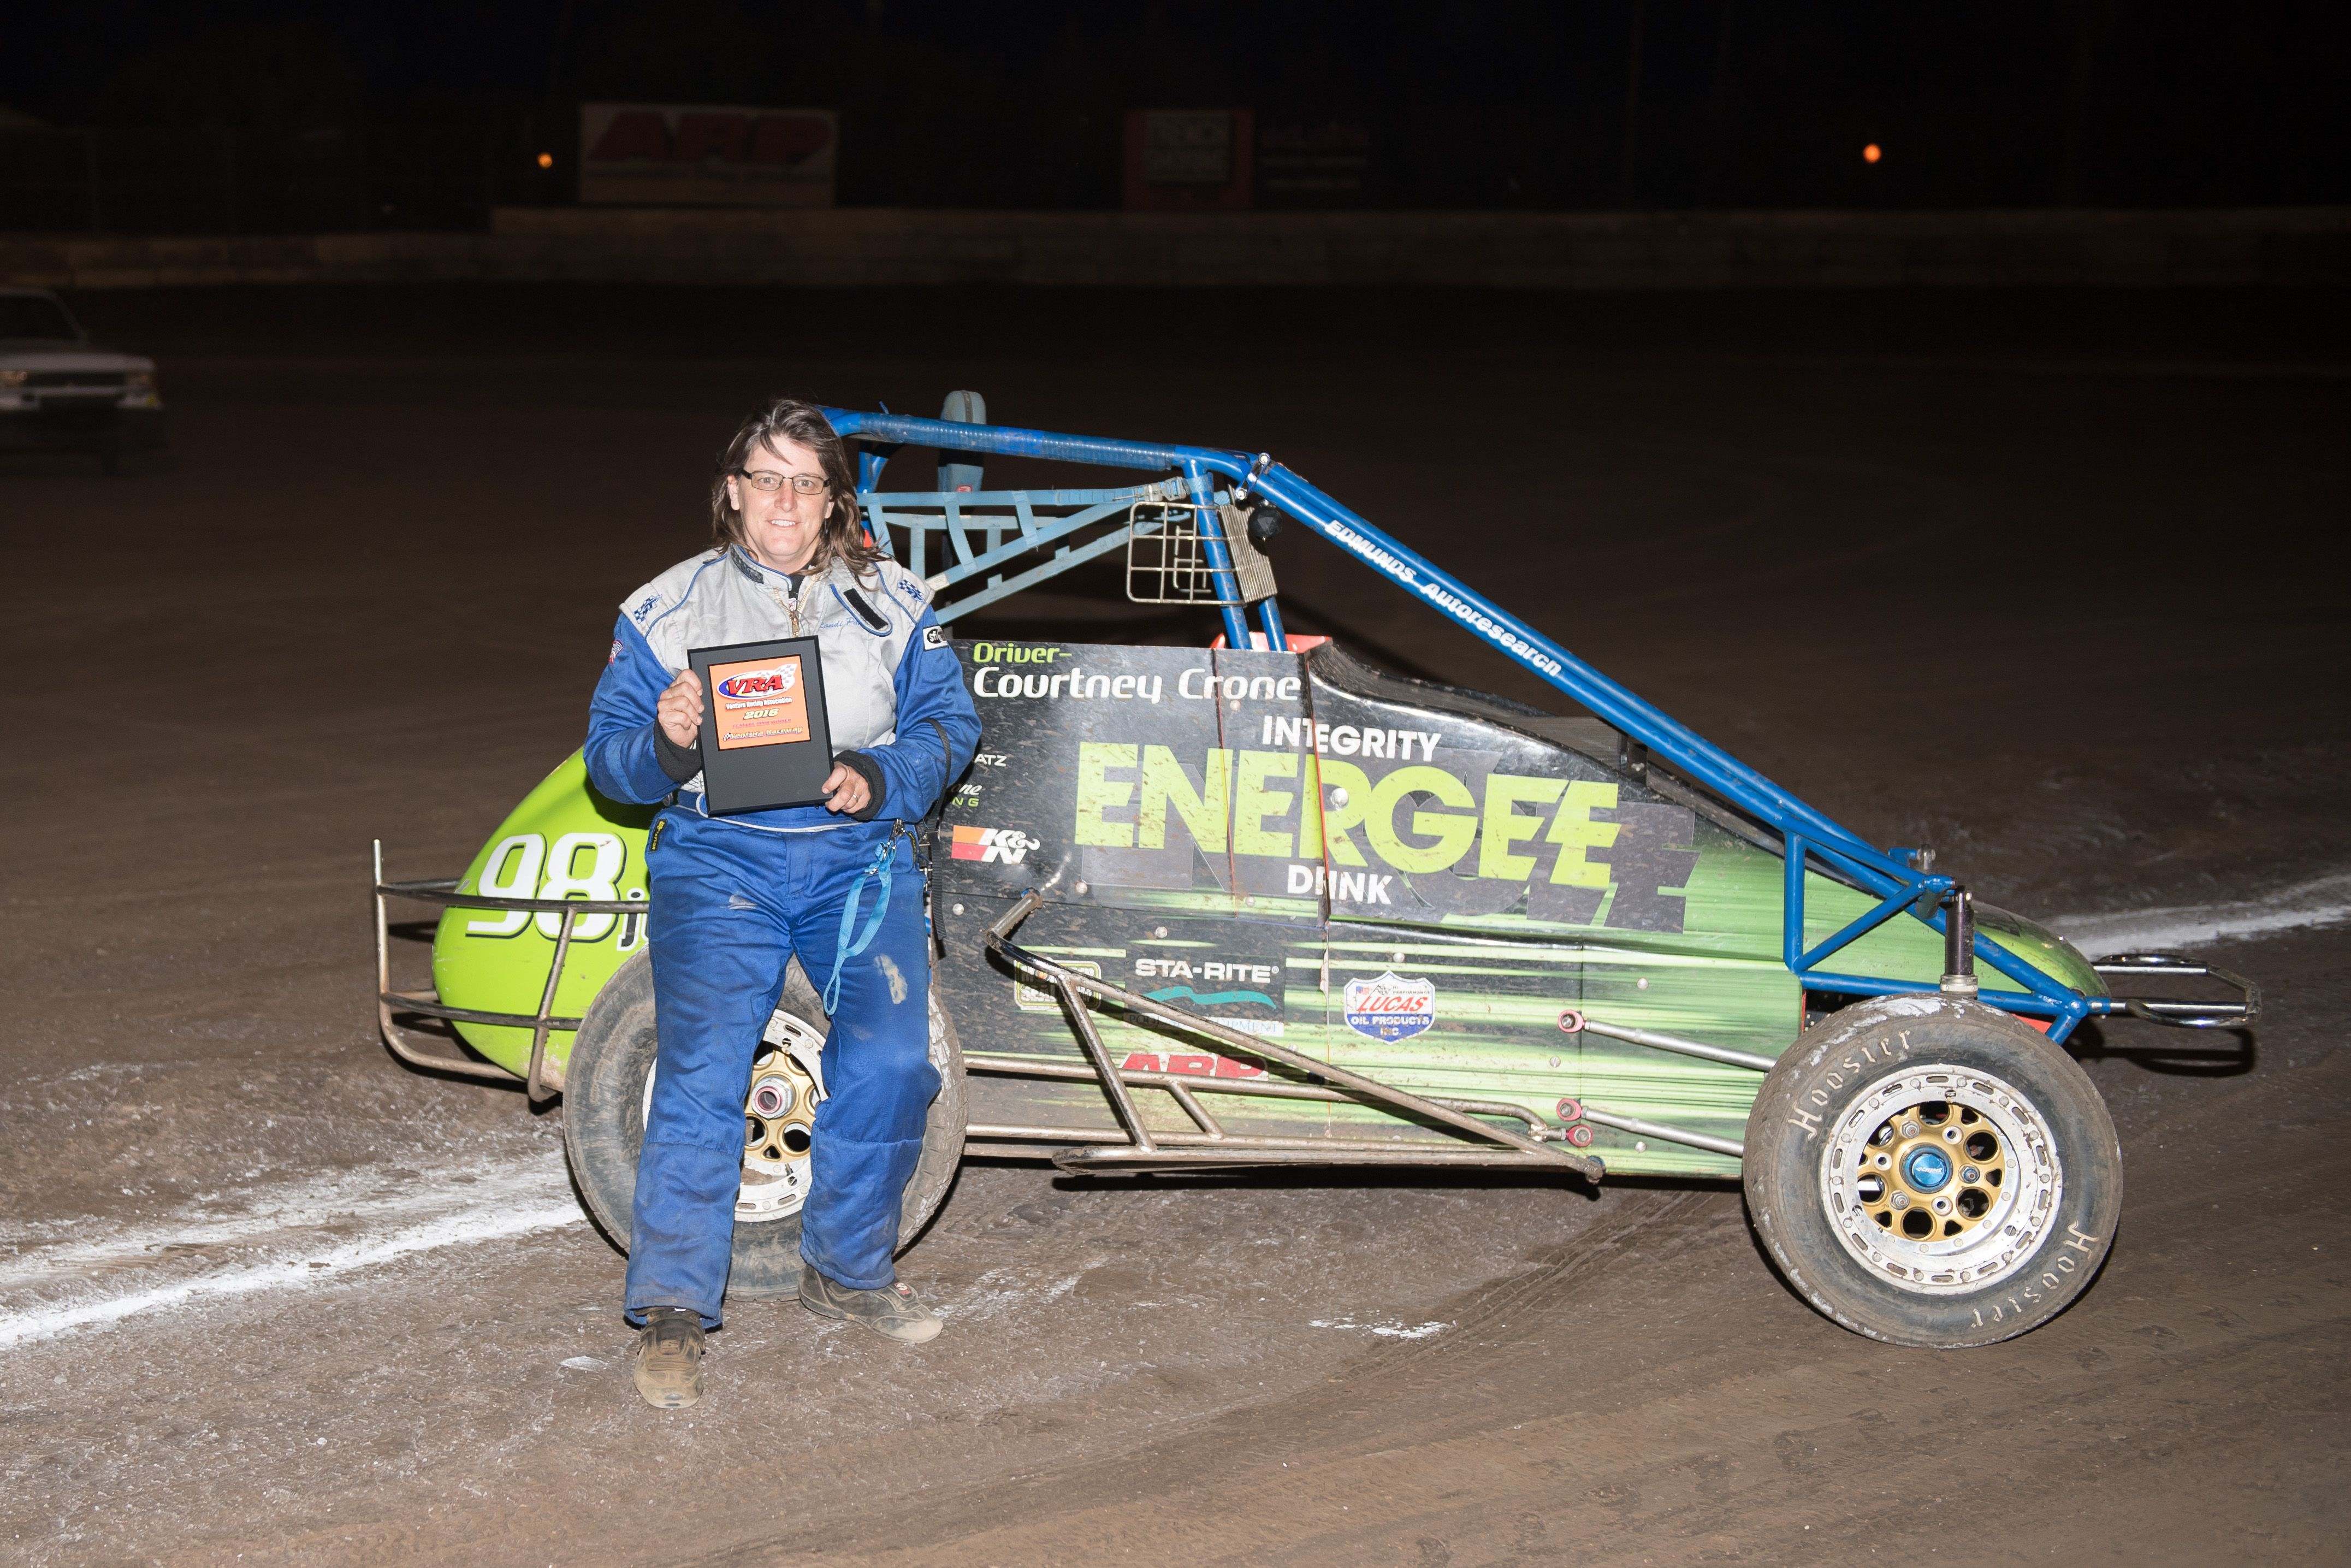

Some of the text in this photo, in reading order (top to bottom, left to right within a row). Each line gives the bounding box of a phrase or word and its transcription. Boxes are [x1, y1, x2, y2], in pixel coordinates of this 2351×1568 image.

[1325, 520, 1417, 583] EDMUNDS
[973, 642, 1072, 663] Driver-
[727, 674, 784, 694] VRA
[974, 666, 1300, 704] Courtney Crone
[764, 697, 792, 705] Association
[743, 708, 779, 720] 2016
[1262, 715, 1442, 761] INTEGRITY
[1074, 741, 1621, 889] ENERGEE
[978, 828, 1040, 865] K&N
[1357, 996, 1428, 1011] LUCAS
[1351, 1016, 1430, 1025] OIL PRODUCTS
